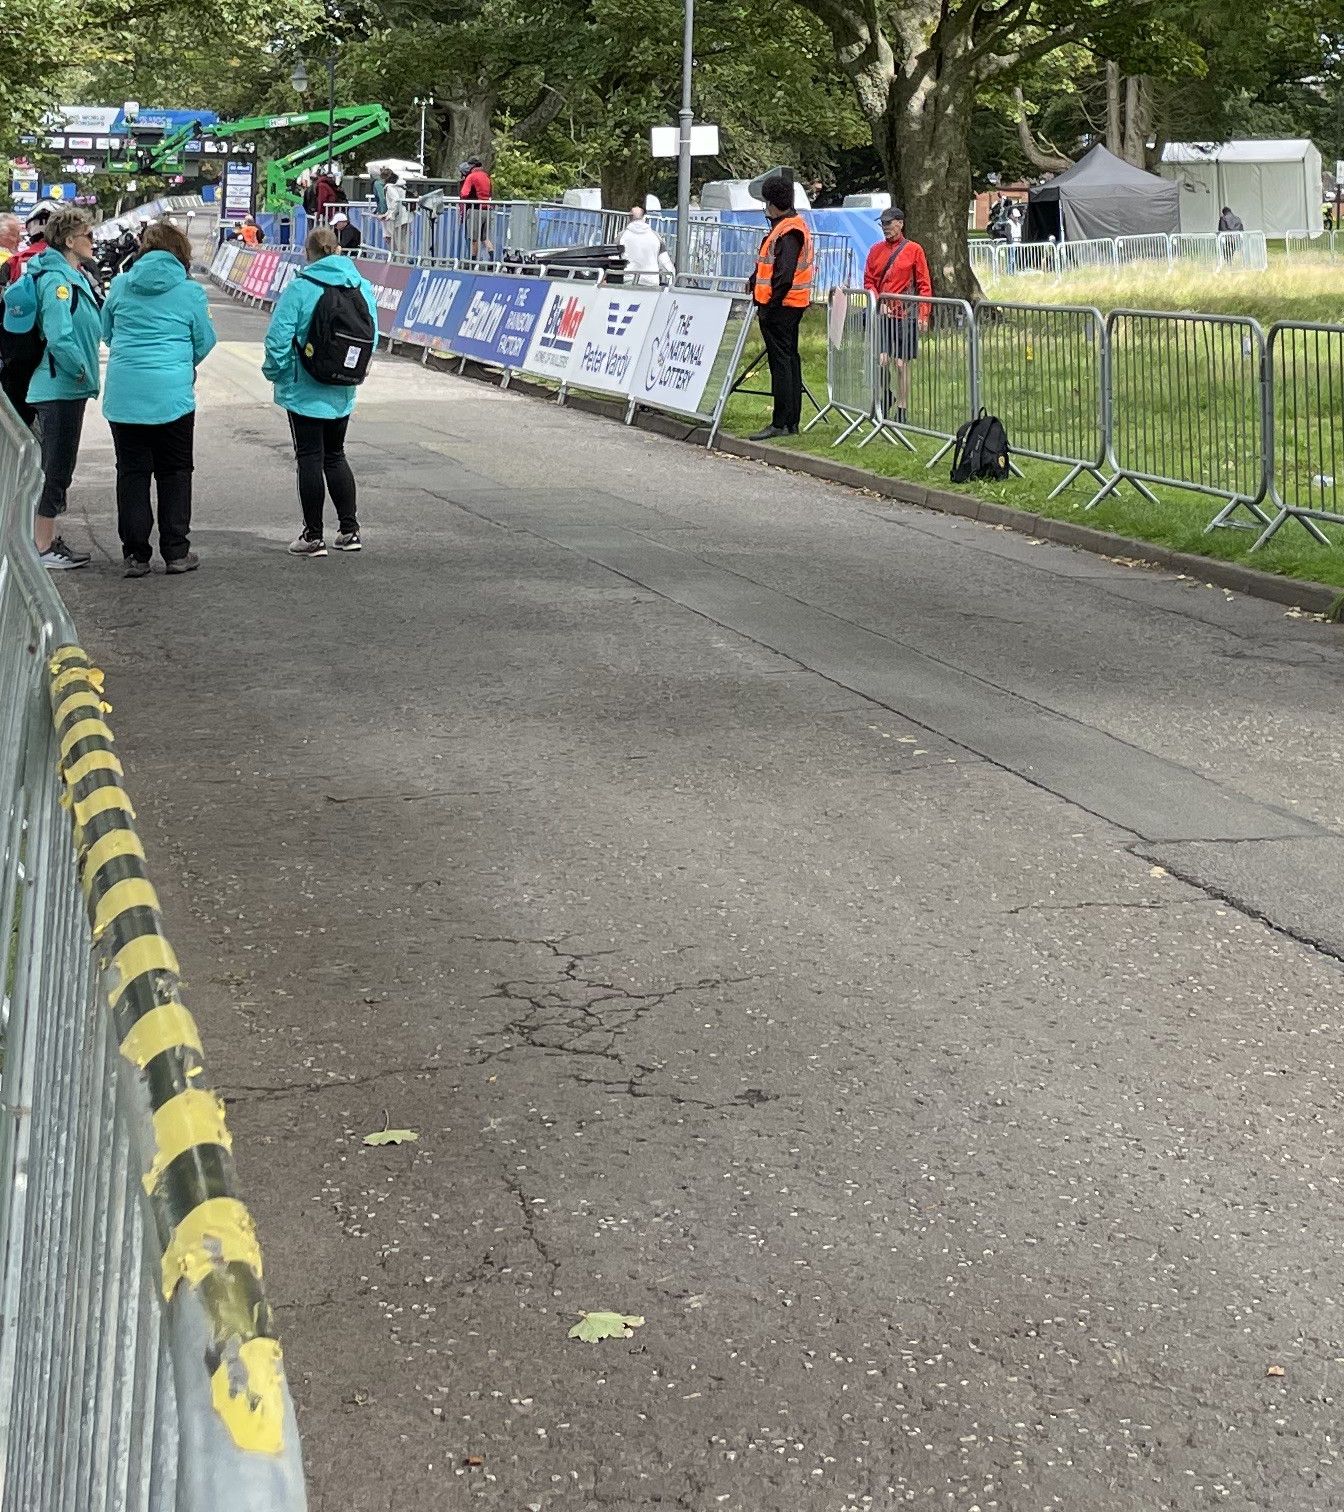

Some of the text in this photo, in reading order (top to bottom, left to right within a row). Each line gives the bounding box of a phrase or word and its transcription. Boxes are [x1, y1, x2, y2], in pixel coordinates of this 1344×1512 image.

[514, 287, 531, 307] THE
[458, 290, 512, 343] Santini
[544, 294, 585, 347] BigMat
[676, 314, 694, 336] THE
[581, 341, 607, 373] Peter
[604, 344, 632, 385] Vardy
[667, 339, 705, 366] NATIONAL
[658, 365, 695, 392] LOTTERY
